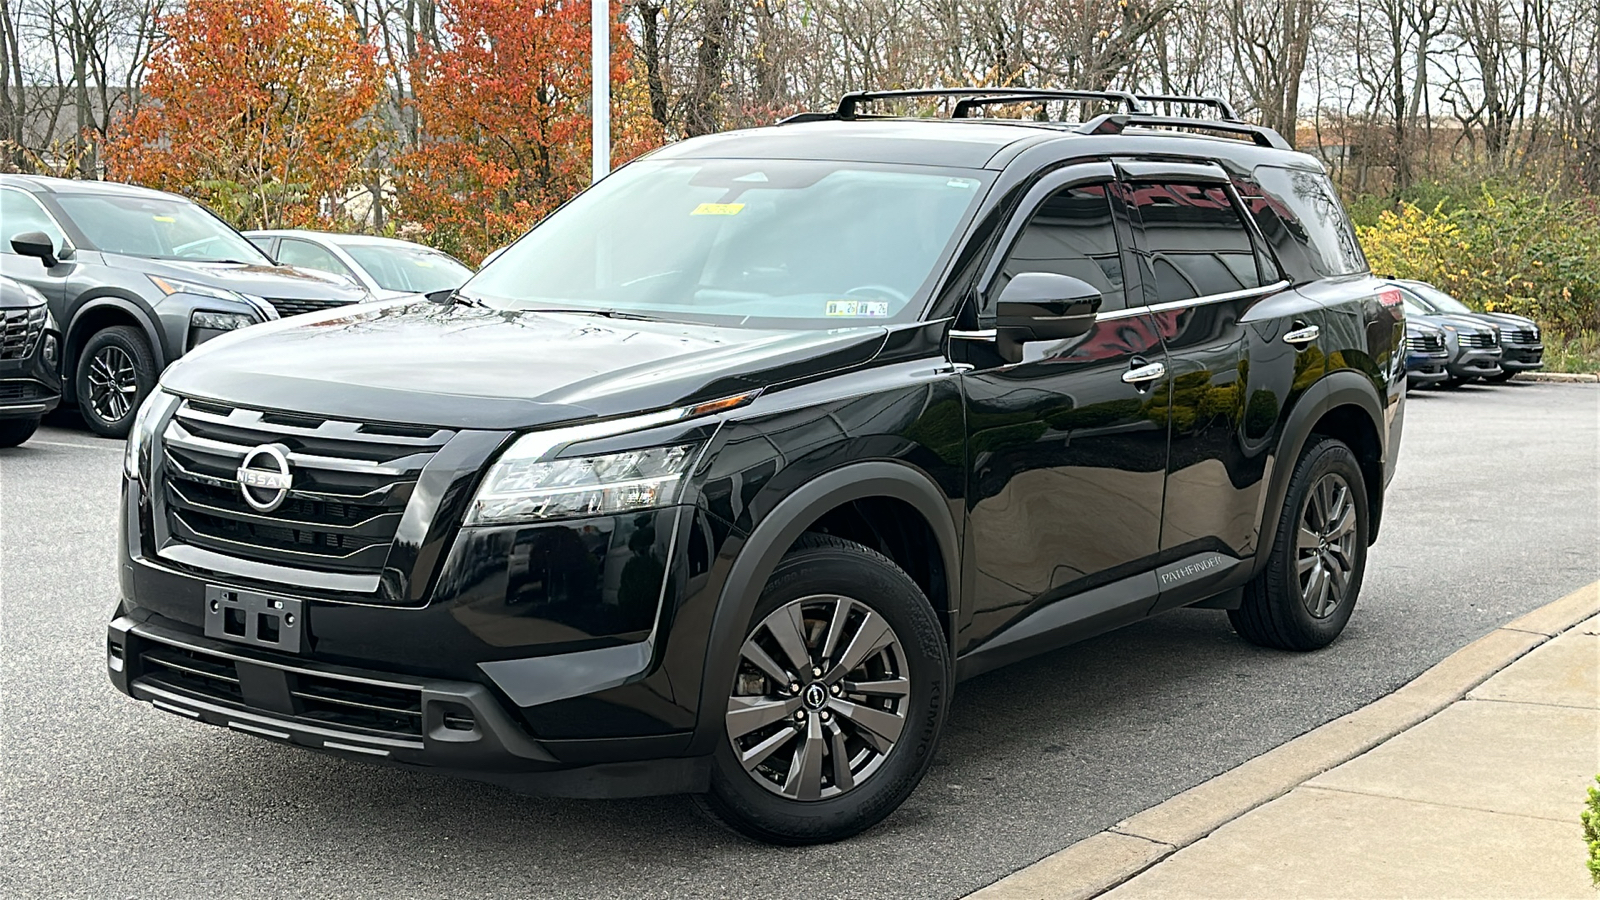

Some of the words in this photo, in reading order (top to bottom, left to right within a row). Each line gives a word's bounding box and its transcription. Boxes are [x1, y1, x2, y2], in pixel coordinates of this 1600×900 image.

[237, 469, 291, 489] NISSAN
[1161, 555, 1222, 584] PATHFINDER
[915, 680, 941, 758] KUMHO
